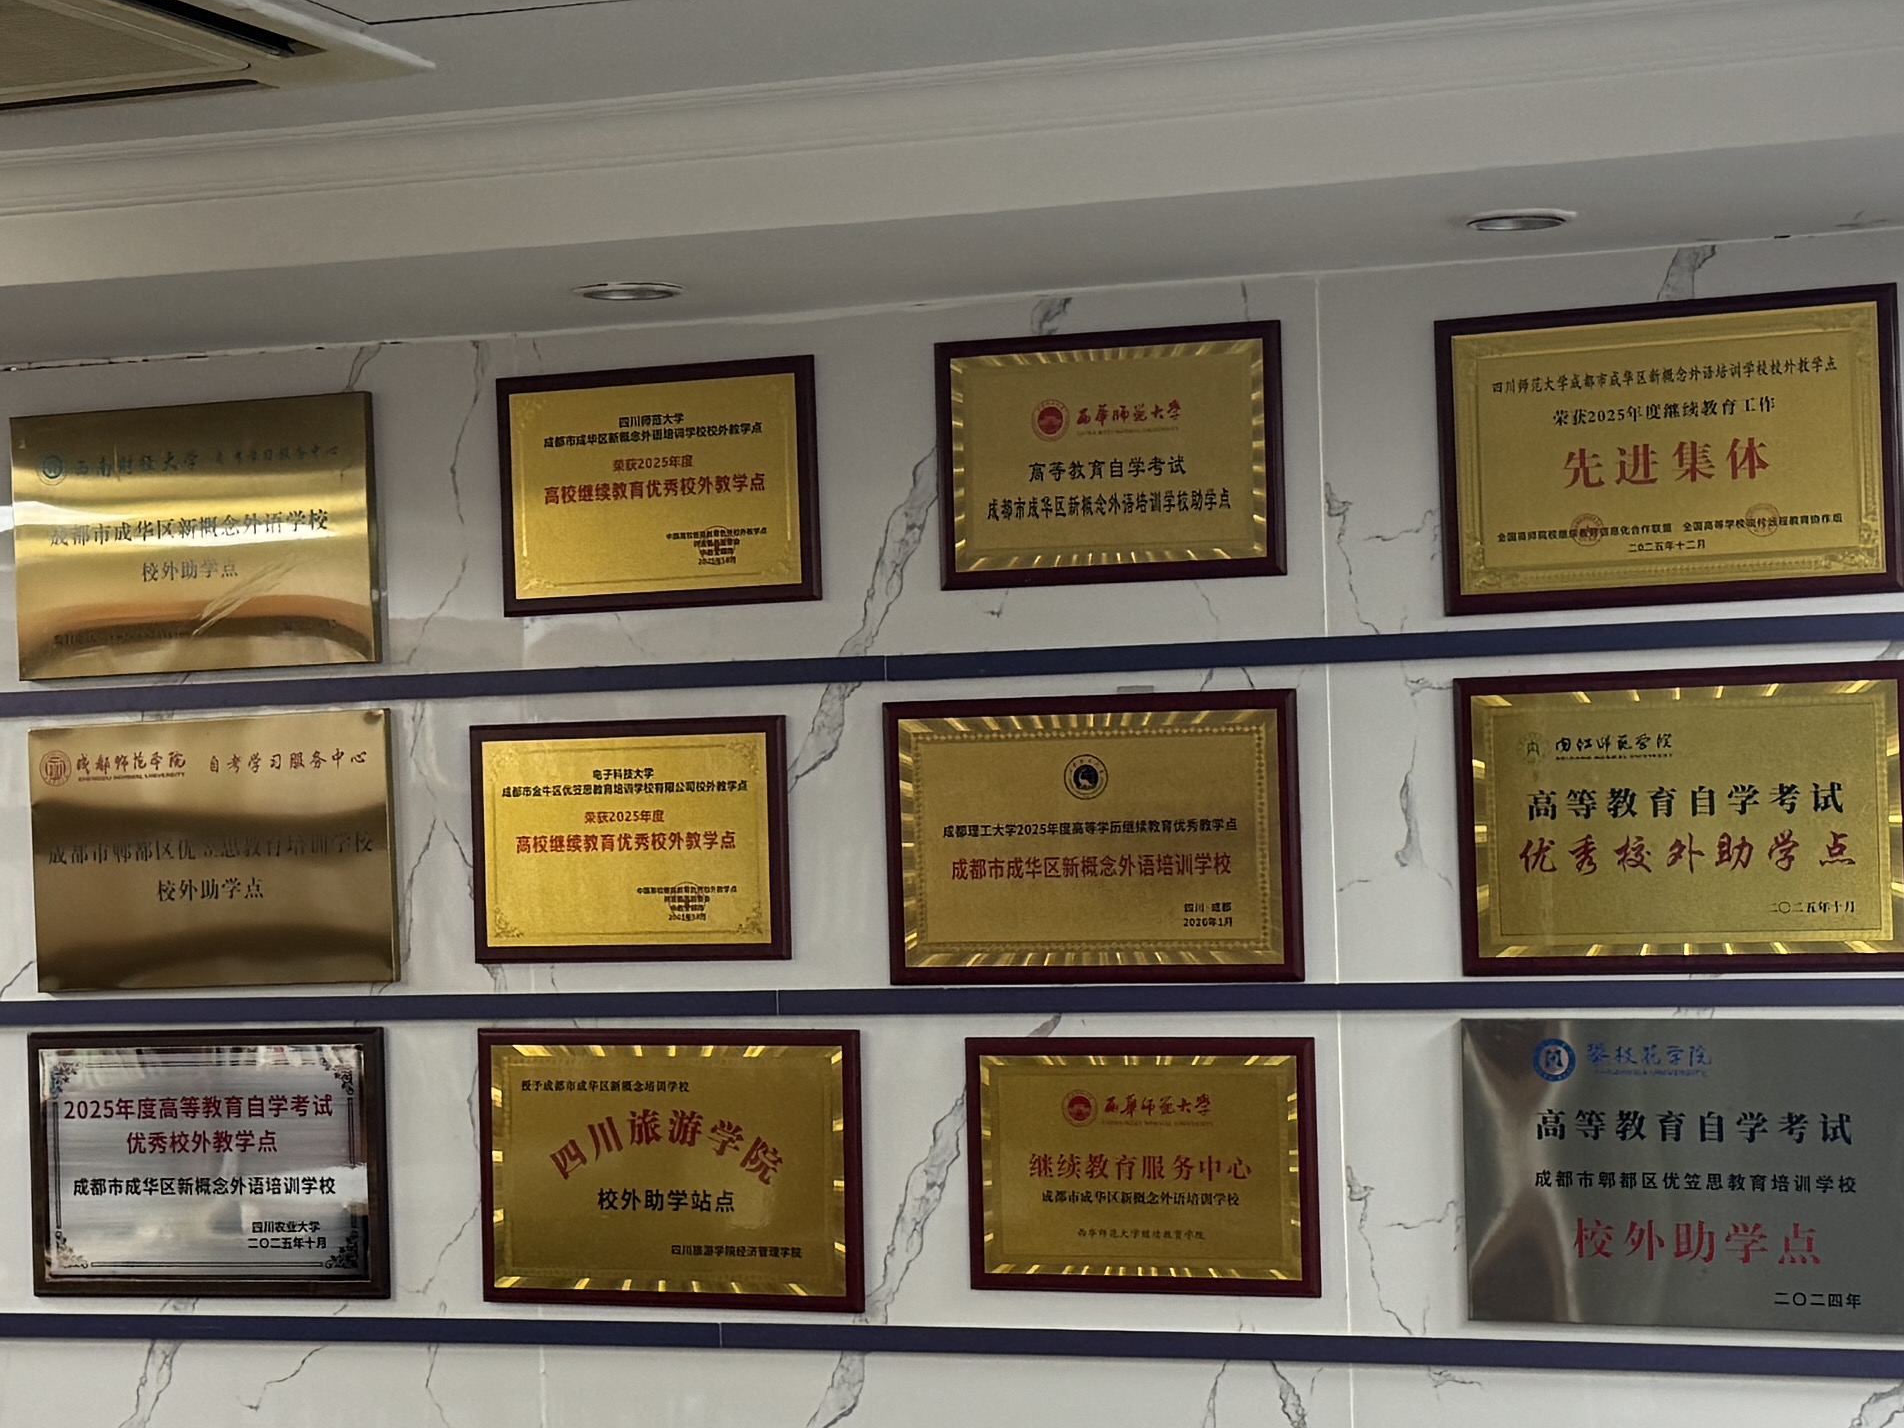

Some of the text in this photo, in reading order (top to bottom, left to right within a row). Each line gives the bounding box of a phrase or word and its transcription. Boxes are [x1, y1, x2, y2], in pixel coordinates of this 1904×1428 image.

[1492, 355, 1838, 395] 四川师范大学成都市成华区新概念外语培训学校校外教学点
[618, 413, 684, 428] 四川师范大学
[1552, 395, 1777, 427] 荣获2025年度继续教育工作
[543, 421, 763, 449] 成都市成华区新概念外语培训学校校外教学点
[612, 454, 693, 473] 荣获2025年度
[1029, 454, 1186, 482] 高等教育自学考试
[1563, 436, 1771, 490] 先进集体
[544, 472, 766, 505] 高校继续教育优秀校外教学点
[987, 487, 1231, 522] 成都市成华区新概念外语培训学校助学点
[50, 508, 329, 547] 成都市成华区新概念外语学校
[142, 560, 239, 583] 校外助学点
[209, 747, 367, 773] 自考学习服务中心
[592, 767, 654, 780] 电子科技大学
[1527, 781, 1845, 822] 高等教育自学考试
[584, 809, 665, 824] 荣获2025年度
[943, 817, 1238, 838] 成都理工大学2025年度高等学历继续教育优秀教学点
[515, 830, 736, 854] 高校继续教育优秀校外教学点
[1518, 828, 1857, 875] 优秀校外助学点
[951, 852, 1232, 881] 成都市成华区新概念外语培训学校
[157, 877, 264, 902] 校外助学点
[521, 1079, 689, 1093] 授予成都市成华区新概念培训学校
[64, 1093, 333, 1121] 2025年度高等教育自学考试
[1536, 1108, 1854, 1146] 高等教育自学考试
[126, 1129, 278, 1154] 优秀校外教学点
[549, 1108, 785, 1185] 四川旅游学院
[1029, 1153, 1252, 1182] 继续教育服务中心
[72, 1176, 336, 1196] 成都市成华区新概念外语培训学校
[1534, 1169, 1858, 1194] 成都市郫都区优笠思教育培训学校
[598, 1188, 735, 1213] 校外助学站点
[1042, 1190, 1240, 1207] 成都市成华区新概念外语培训学校
[252, 1221, 321, 1233] 四川农业大学
[671, 1244, 803, 1259] 四川旅游学院经济管理学院
[1573, 1217, 1822, 1266] 校外助学点
